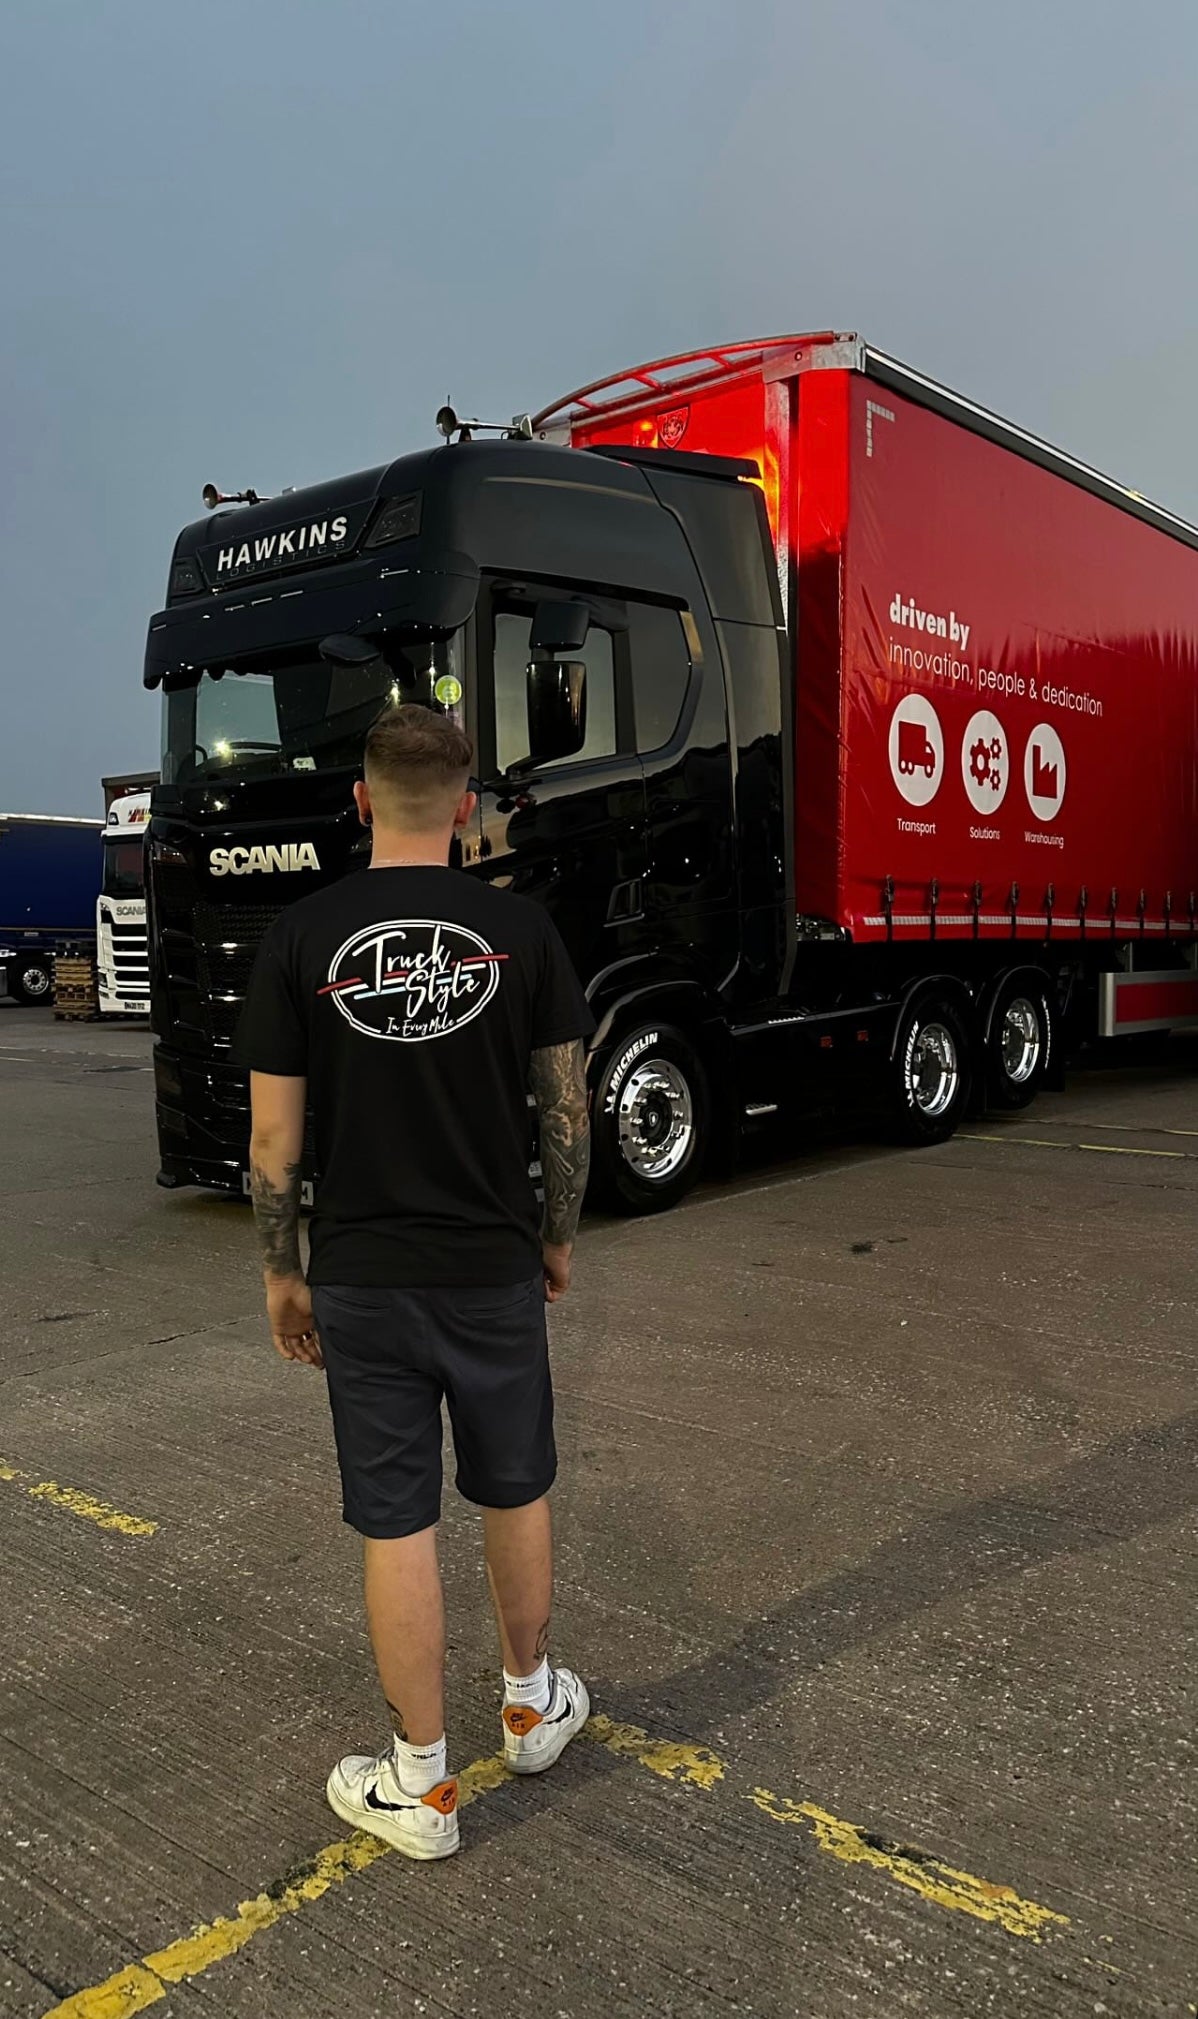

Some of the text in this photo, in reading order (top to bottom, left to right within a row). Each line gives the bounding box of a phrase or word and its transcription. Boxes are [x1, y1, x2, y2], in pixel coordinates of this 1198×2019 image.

[215, 540, 345, 581] LOGISTICS
[217, 516, 348, 572] HAWKINS
[889, 592, 970, 651] driven by
[889, 636, 1103, 717] innovation, people & dedication
[896, 817, 937, 836] Transport
[969, 826, 1001, 840] Solutions
[1024, 831, 1064, 849] Warehousing
[209, 842, 321, 876] SCANIA
[352, 925, 452, 994] Truck
[405, 961, 481, 1018] Style
[385, 1011, 455, 1038] In Every Mile
[609, 1032, 658, 1092] MICHELIN
[905, 1020, 919, 1089] MICHELIN
